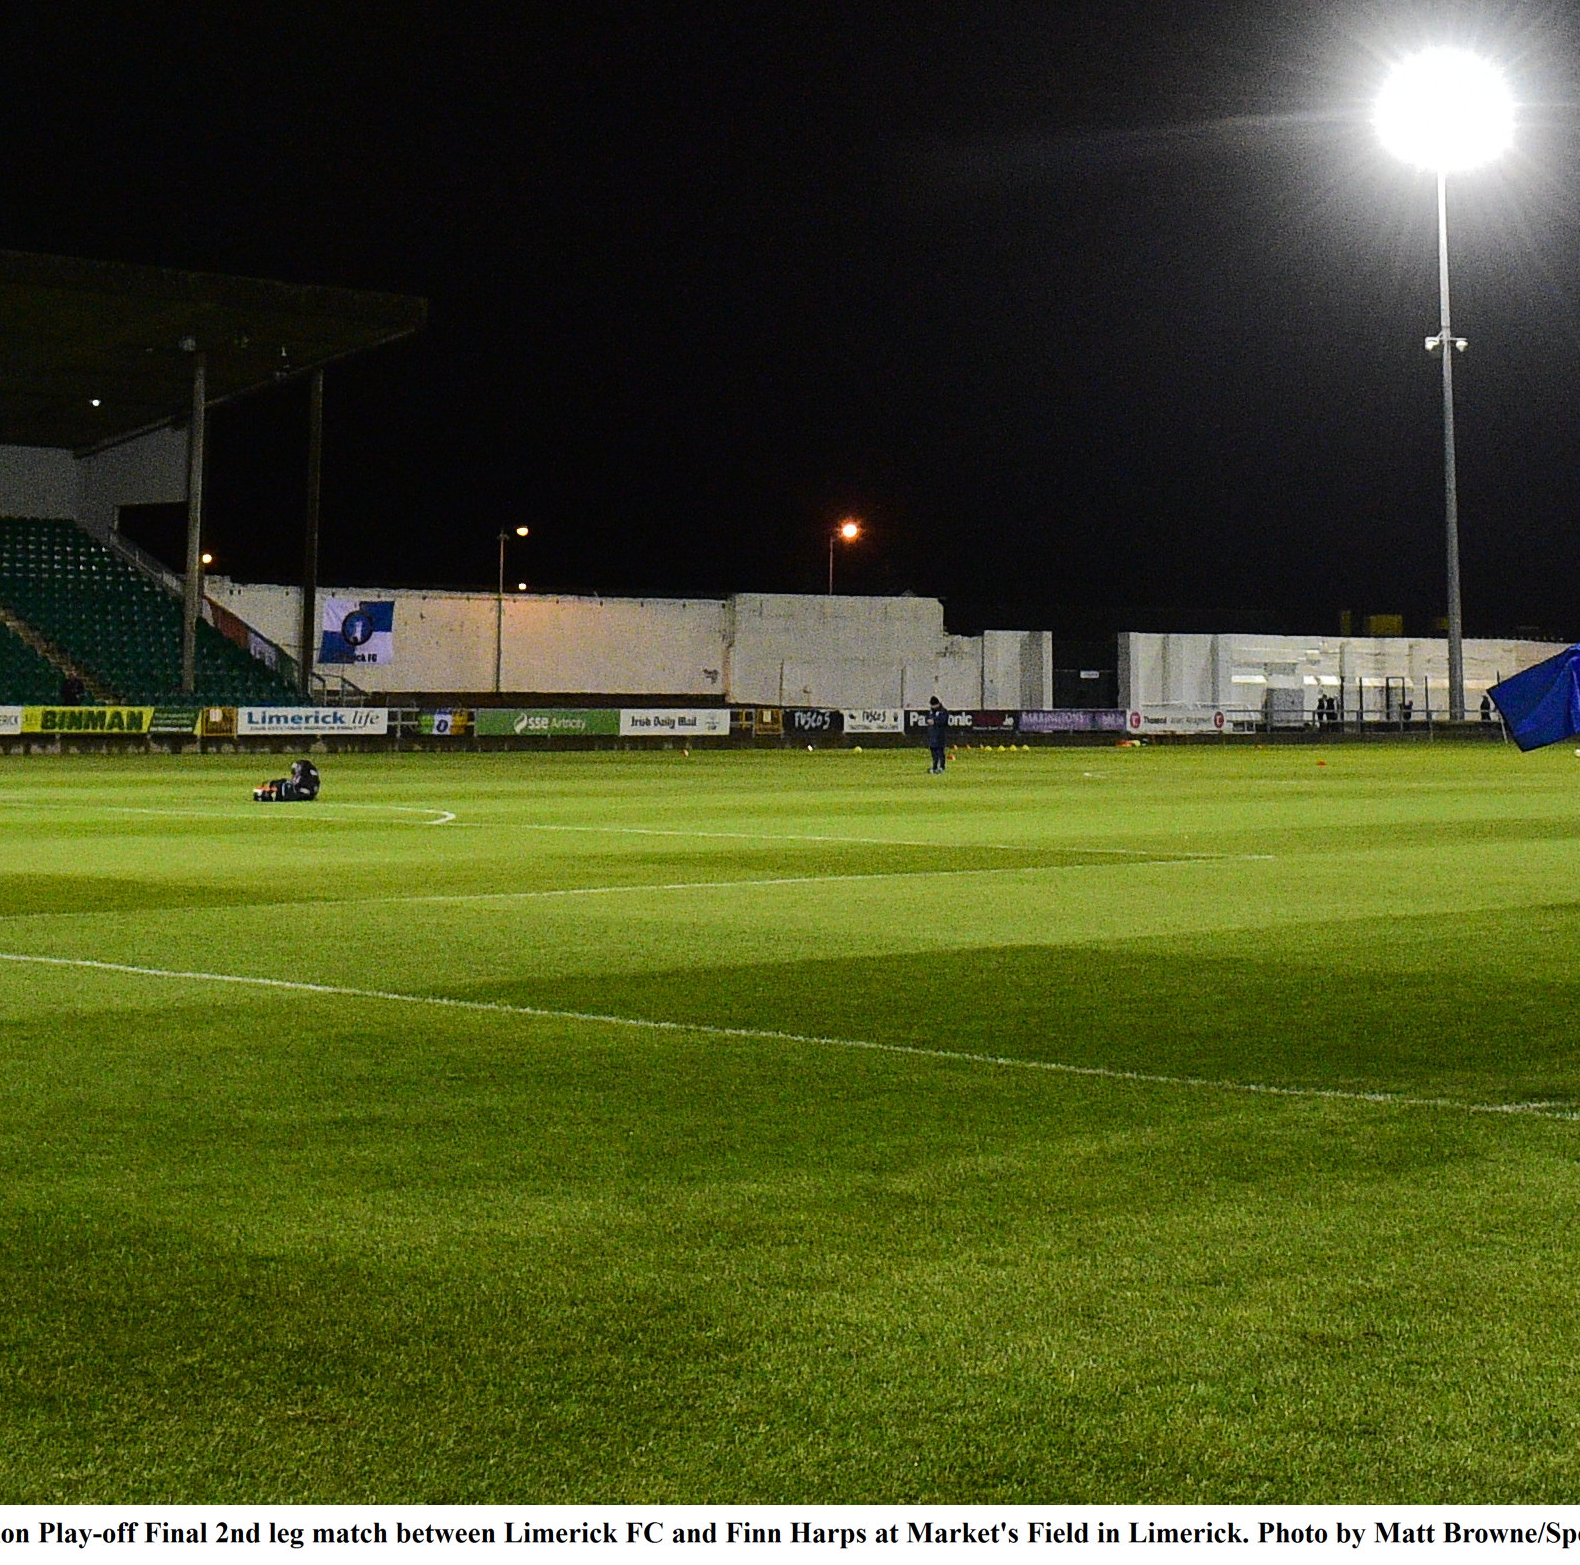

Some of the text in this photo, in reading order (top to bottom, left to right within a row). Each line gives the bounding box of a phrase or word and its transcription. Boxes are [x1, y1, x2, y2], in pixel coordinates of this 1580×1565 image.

[41, 709, 144, 730] BINMAN
[247, 710, 380, 726] Limerick life
[910, 712, 973, 727] Paonic
